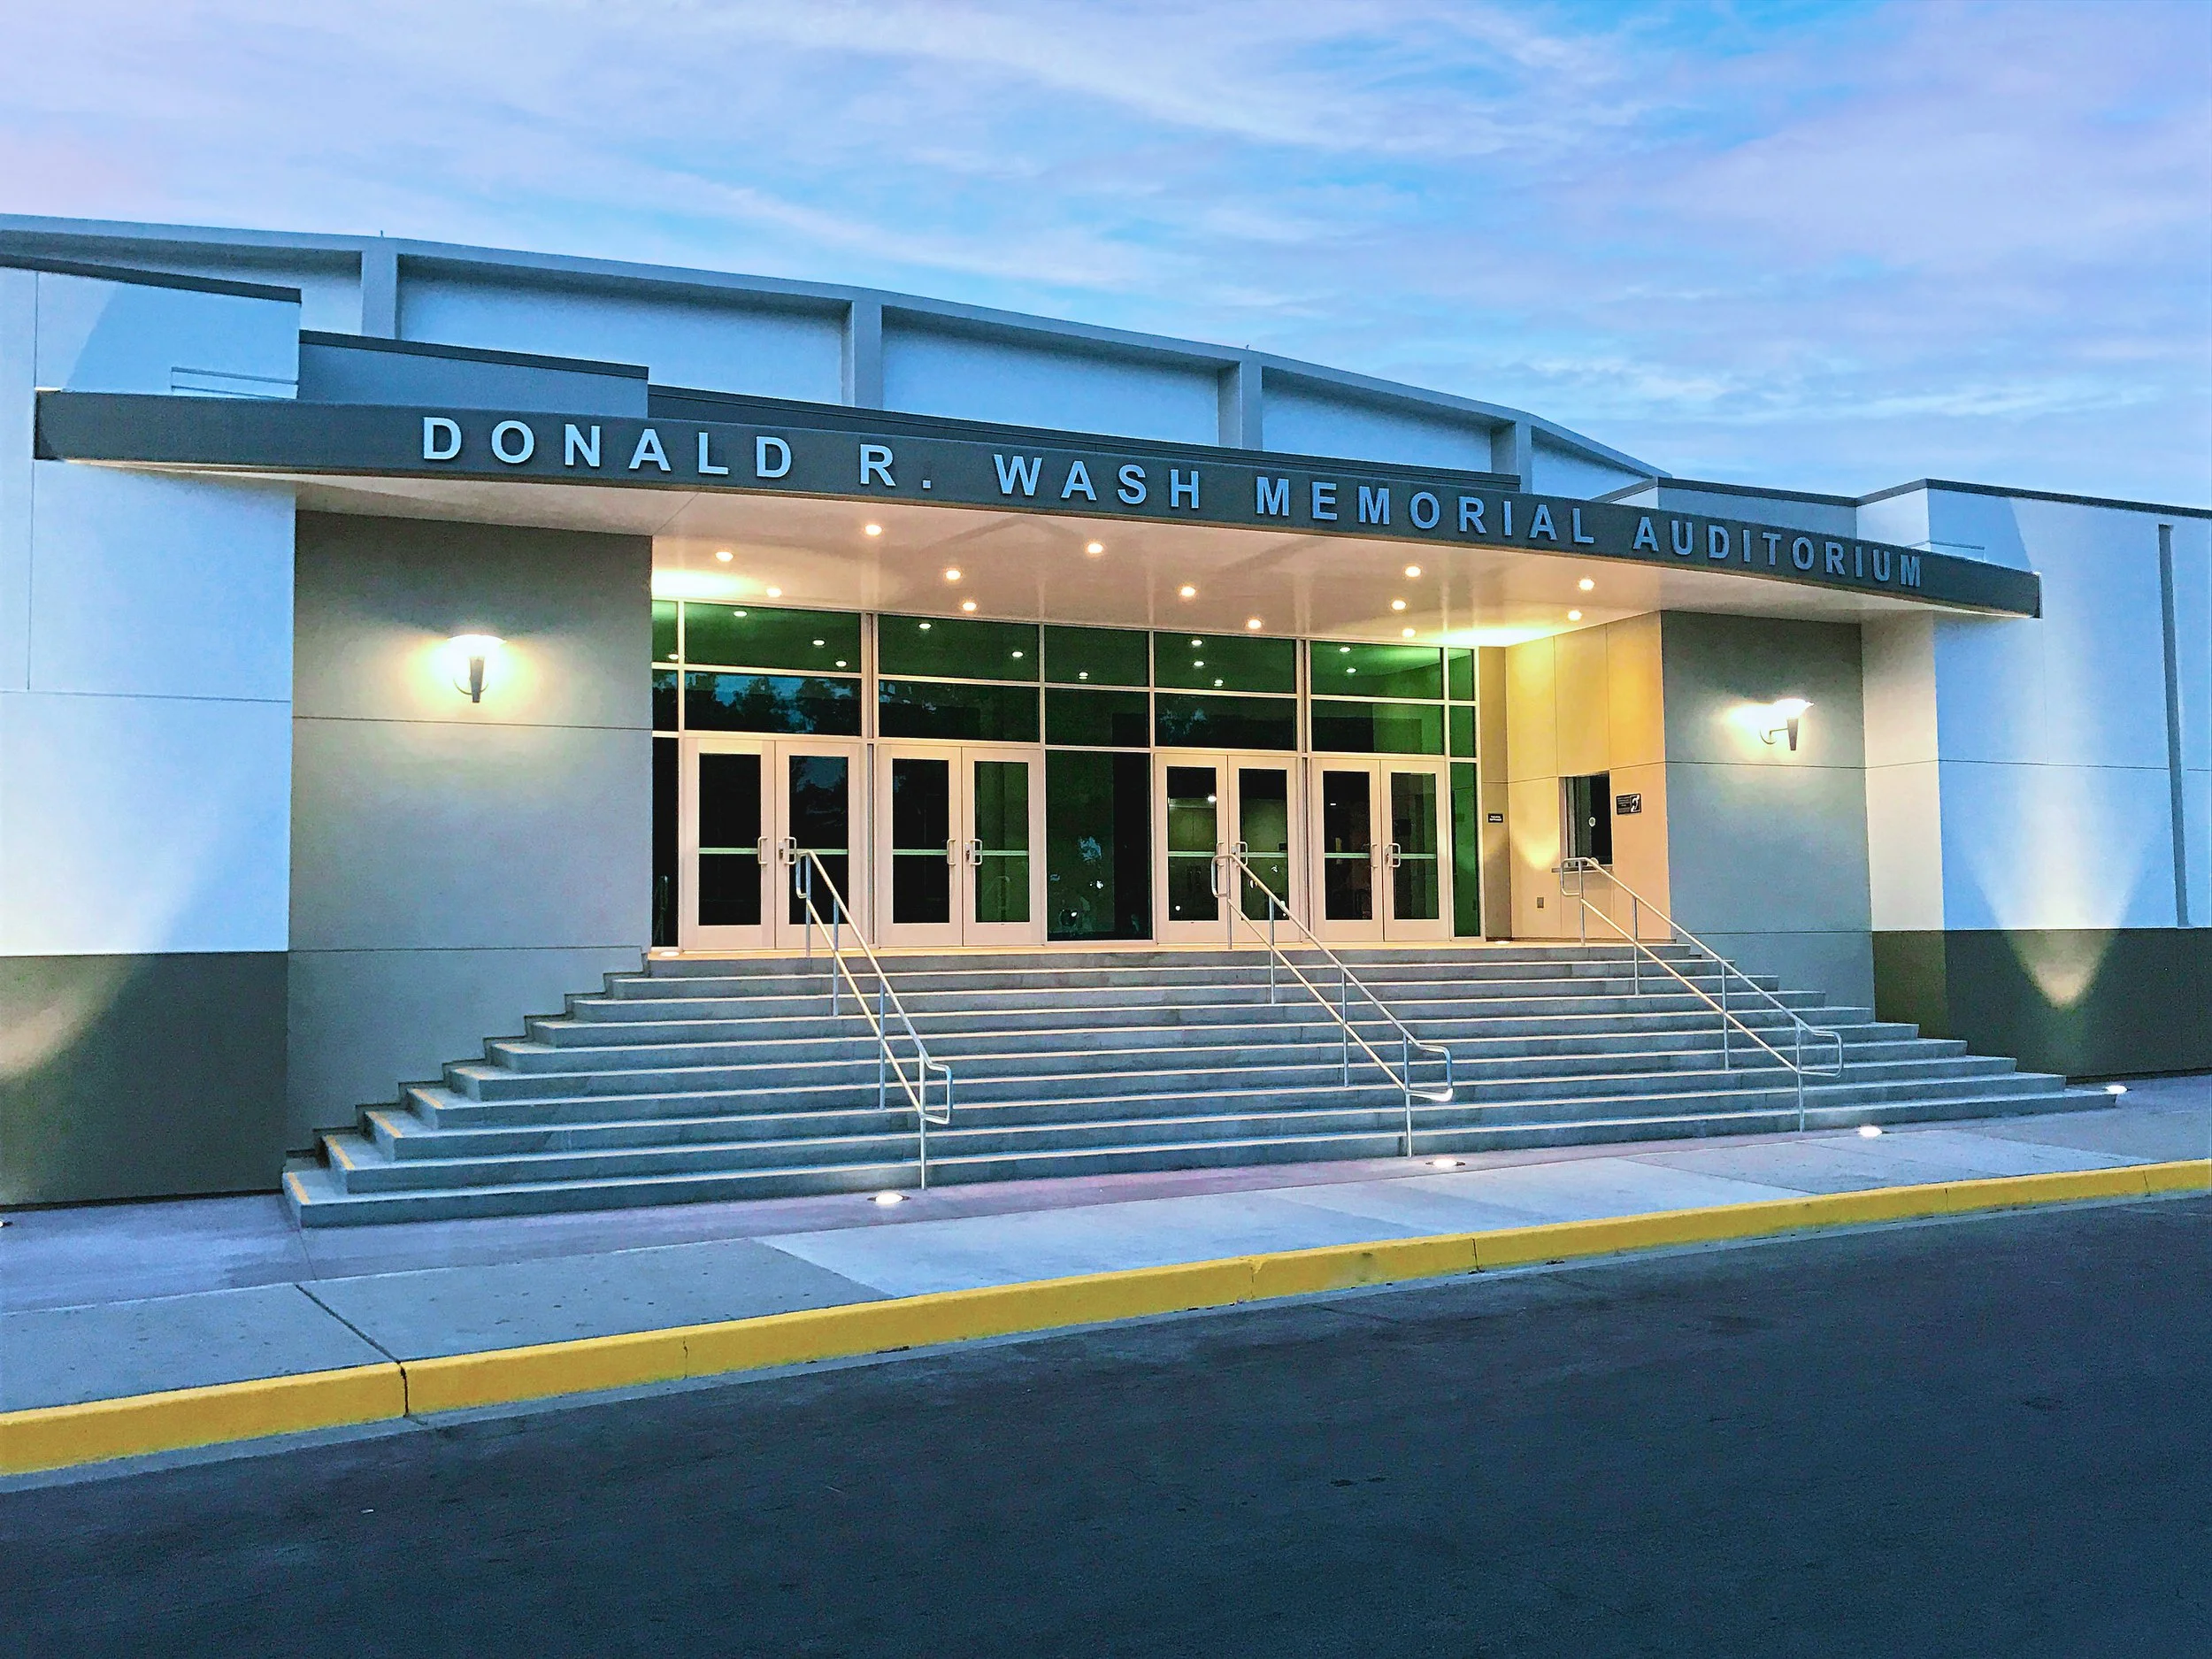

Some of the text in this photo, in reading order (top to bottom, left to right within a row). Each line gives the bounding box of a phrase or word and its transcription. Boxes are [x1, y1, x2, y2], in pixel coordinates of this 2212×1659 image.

[423, 417, 1922, 588] DONALD R. WASH MEMORIAL AUDITORIUM
